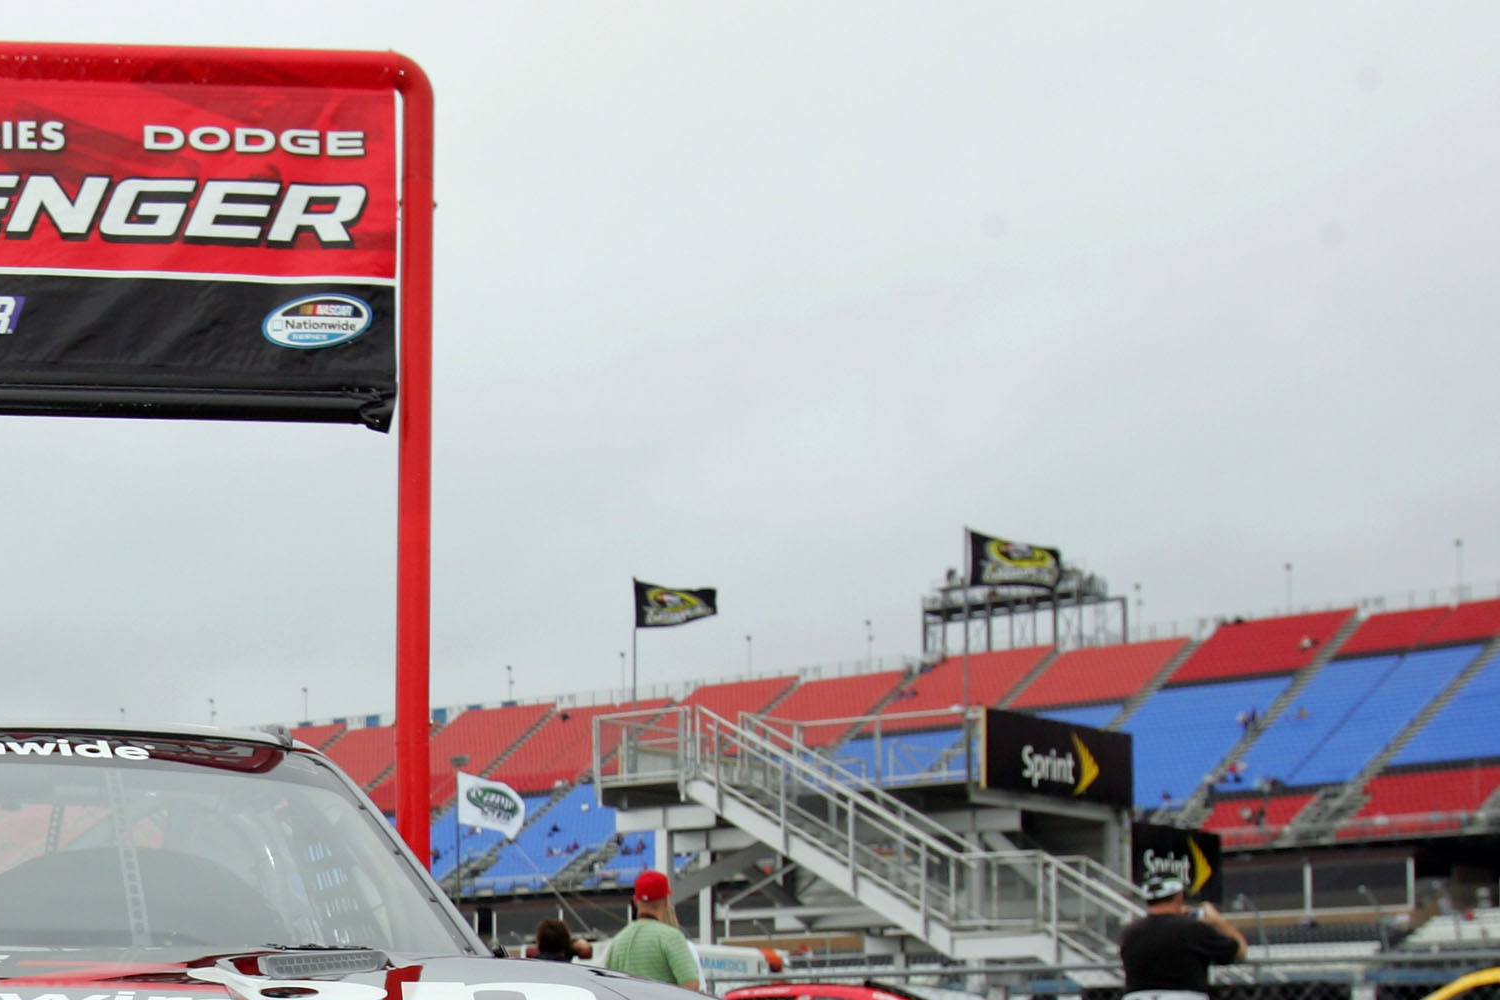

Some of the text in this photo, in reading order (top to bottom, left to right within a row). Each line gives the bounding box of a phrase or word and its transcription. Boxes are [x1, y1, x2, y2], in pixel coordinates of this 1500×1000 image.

[143, 124, 366, 157] DODGE
[285, 319, 357, 332] Nationwide
[1021, 744, 1076, 788] Sprint
